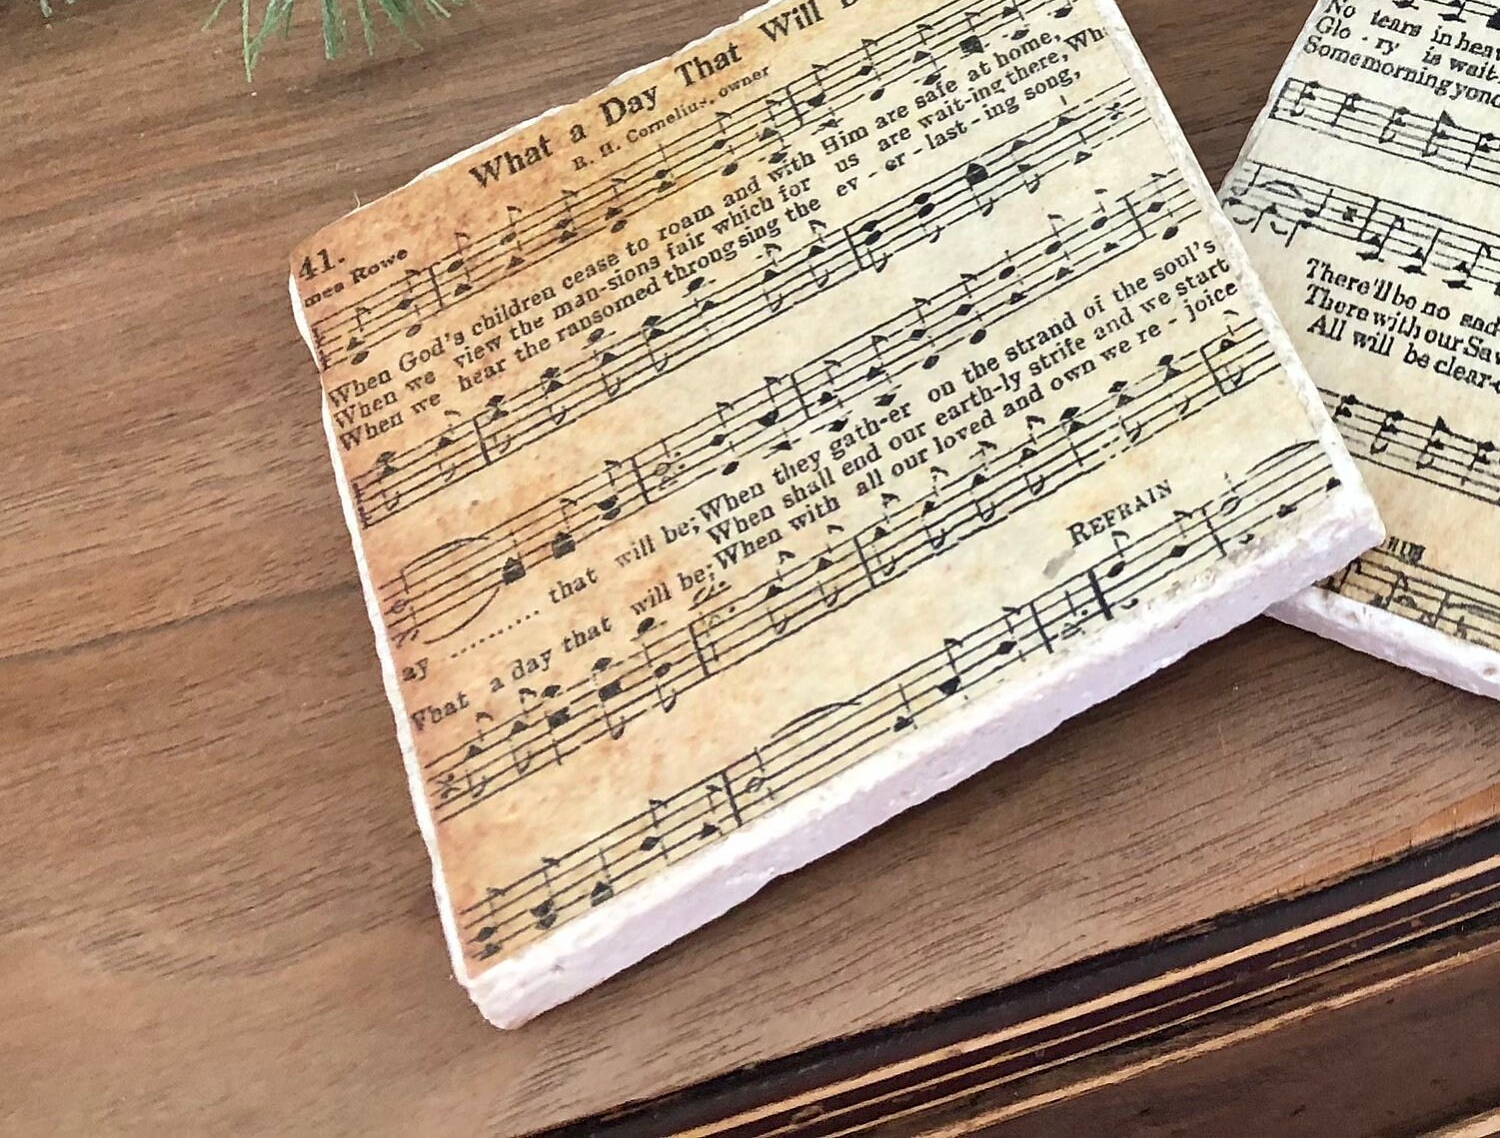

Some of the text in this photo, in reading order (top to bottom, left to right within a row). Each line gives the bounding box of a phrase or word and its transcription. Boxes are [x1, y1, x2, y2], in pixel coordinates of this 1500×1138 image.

[468, 134, 554, 189] What
[569, 123, 588, 144] a
[598, 85, 658, 127] Day
[673, 42, 743, 88] That
[298, 248, 346, 282] 41.
[327, 32, 1068, 408] When God's children cease to roam and with Him are safe at home,
[338, 68, 1081, 452] When we hear the ransomed throng sing the song,
[349, 249, 408, 285] Rowe
[1306, 257, 1394, 302] There'll
[1391, 283, 1417, 317] be
[1420, 301, 1451, 321] no
[548, 567, 598, 604] that
[614, 533, 656, 568] will
[695, 482, 766, 522] When
[771, 449, 821, 486] they
[927, 380, 956, 403] on
[961, 357, 1000, 385] the
[1004, 310, 1078, 363] strand
[1112, 277, 1149, 303] the
[1152, 240, 1216, 282] soul's
